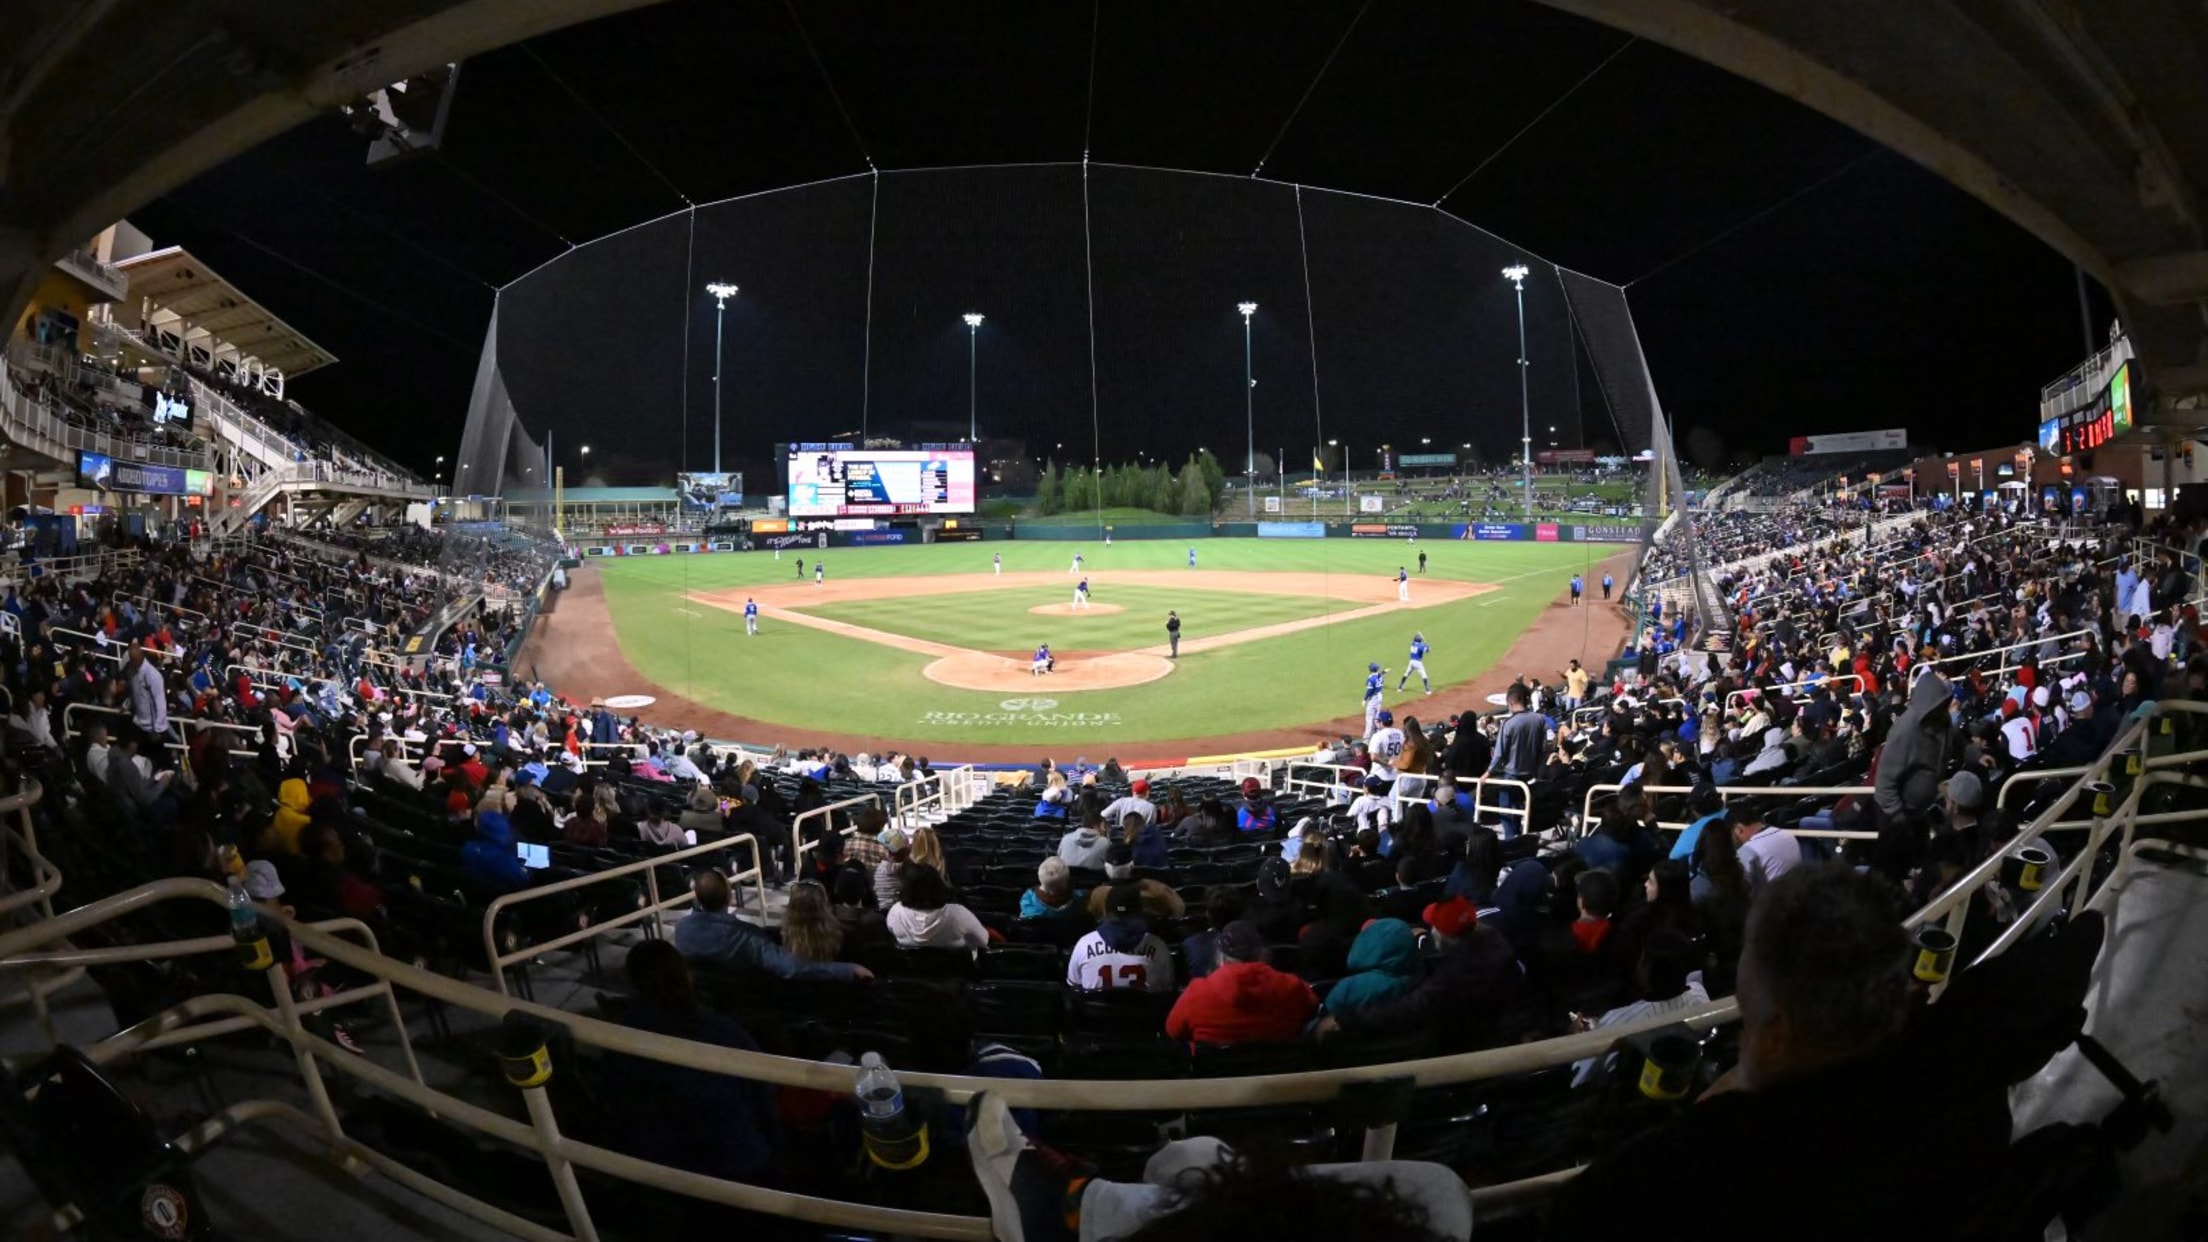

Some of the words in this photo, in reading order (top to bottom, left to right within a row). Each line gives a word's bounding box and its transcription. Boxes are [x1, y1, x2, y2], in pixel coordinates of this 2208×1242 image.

[1588, 527, 1641, 535] GONSTEAD
[923, 711, 980, 721] RIO
[980, 711, 1122, 721] GRANDE
[2021, 726, 2034, 752] 1
[1386, 742, 1402, 757] 50
